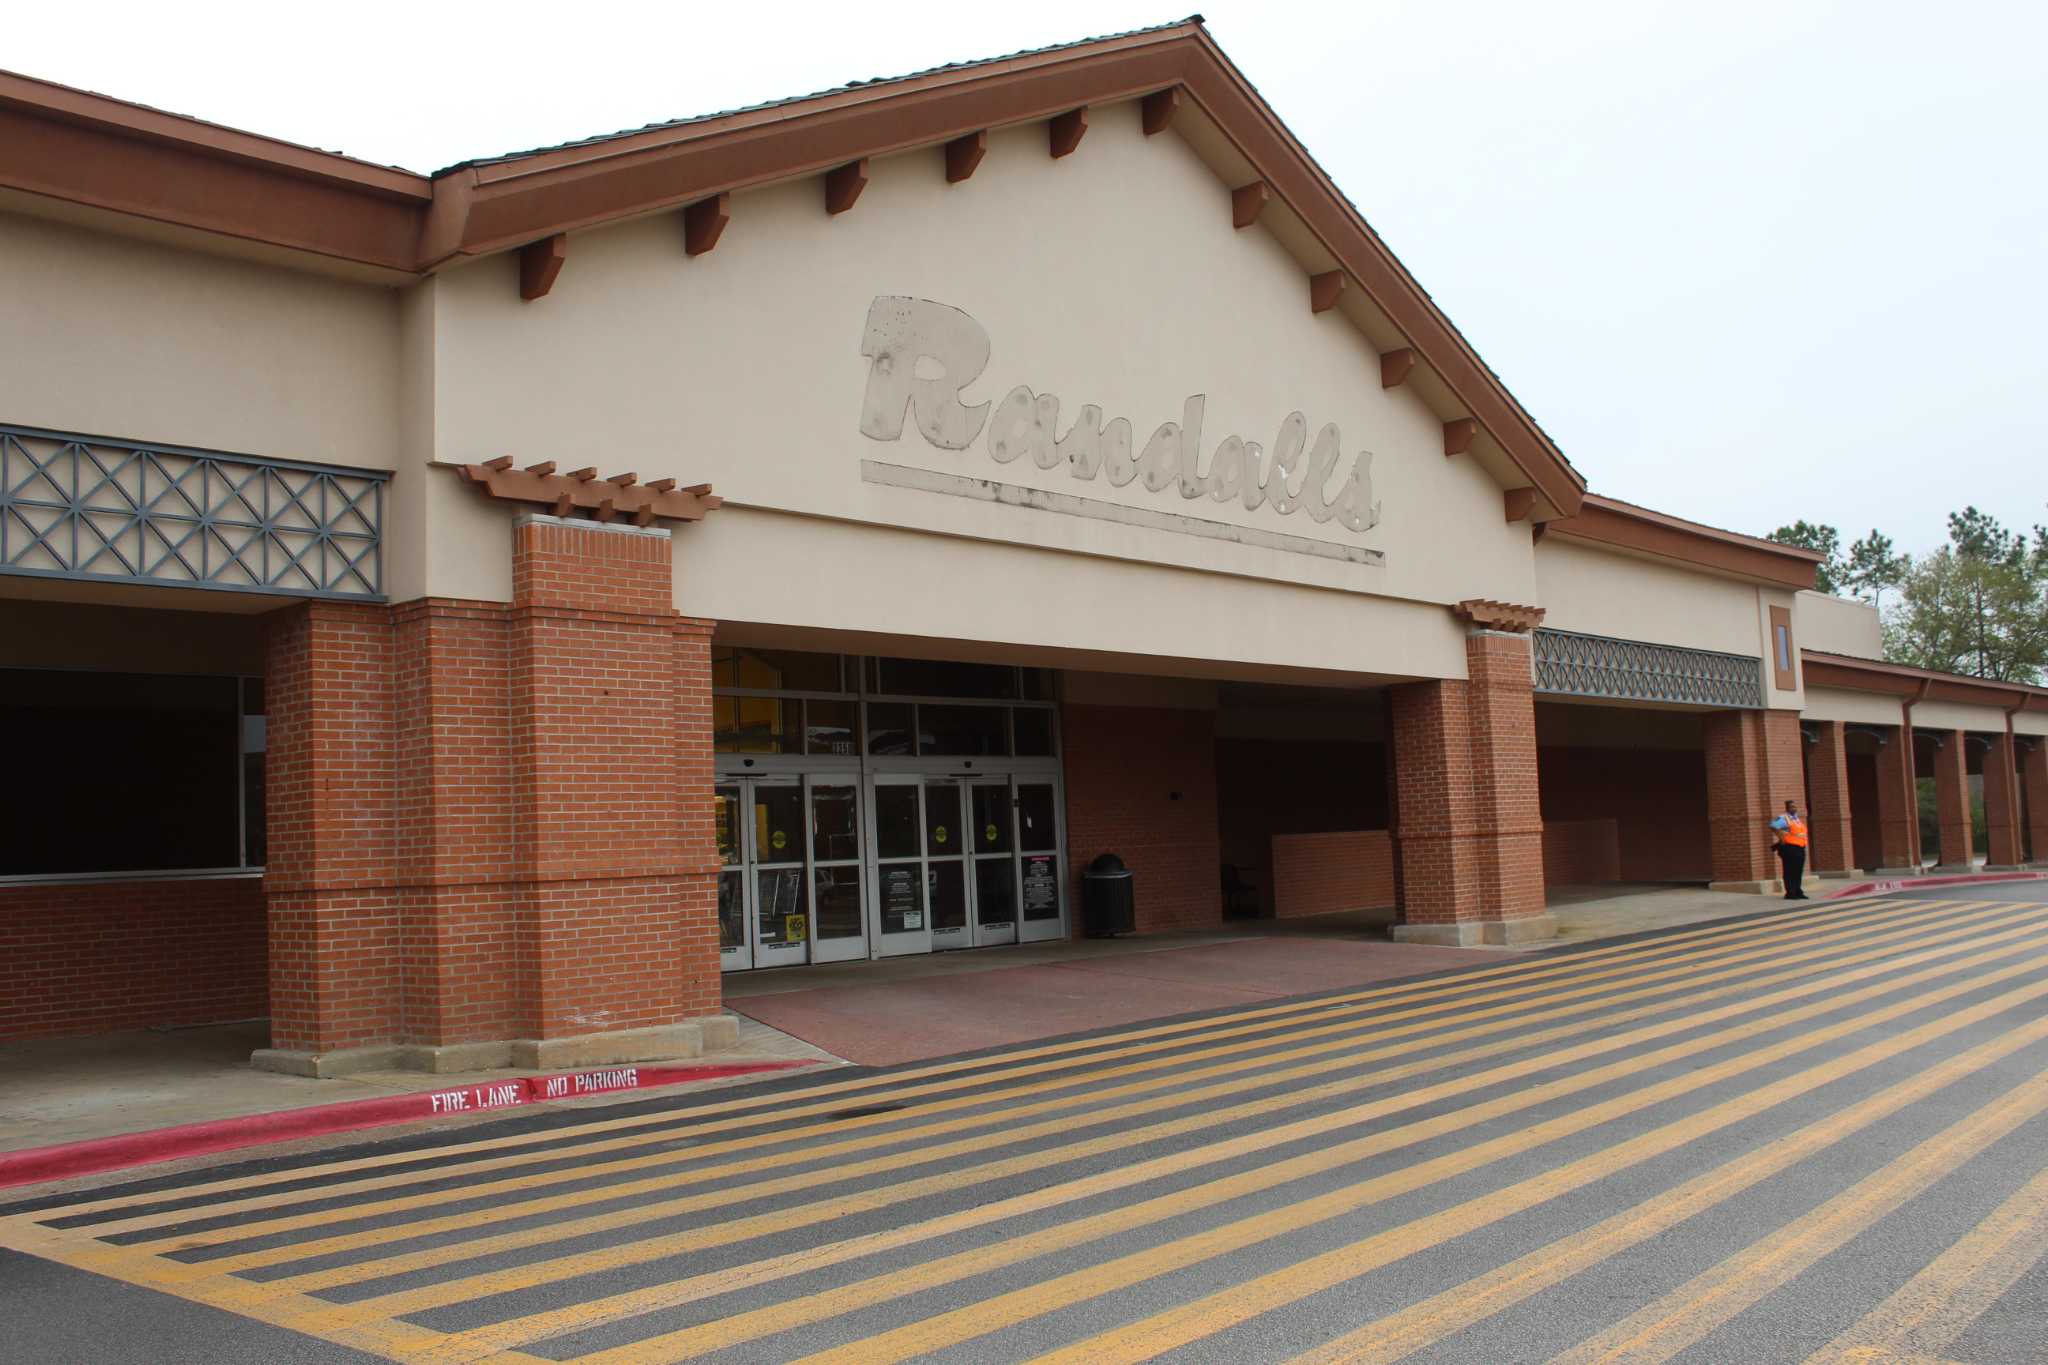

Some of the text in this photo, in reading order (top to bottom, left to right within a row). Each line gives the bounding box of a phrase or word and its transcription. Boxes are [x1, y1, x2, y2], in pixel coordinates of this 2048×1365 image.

[860, 295, 1382, 532] Randalls
[546, 1069, 638, 1097] NO PARKING
[431, 1084, 522, 1113] FIRE LANE
